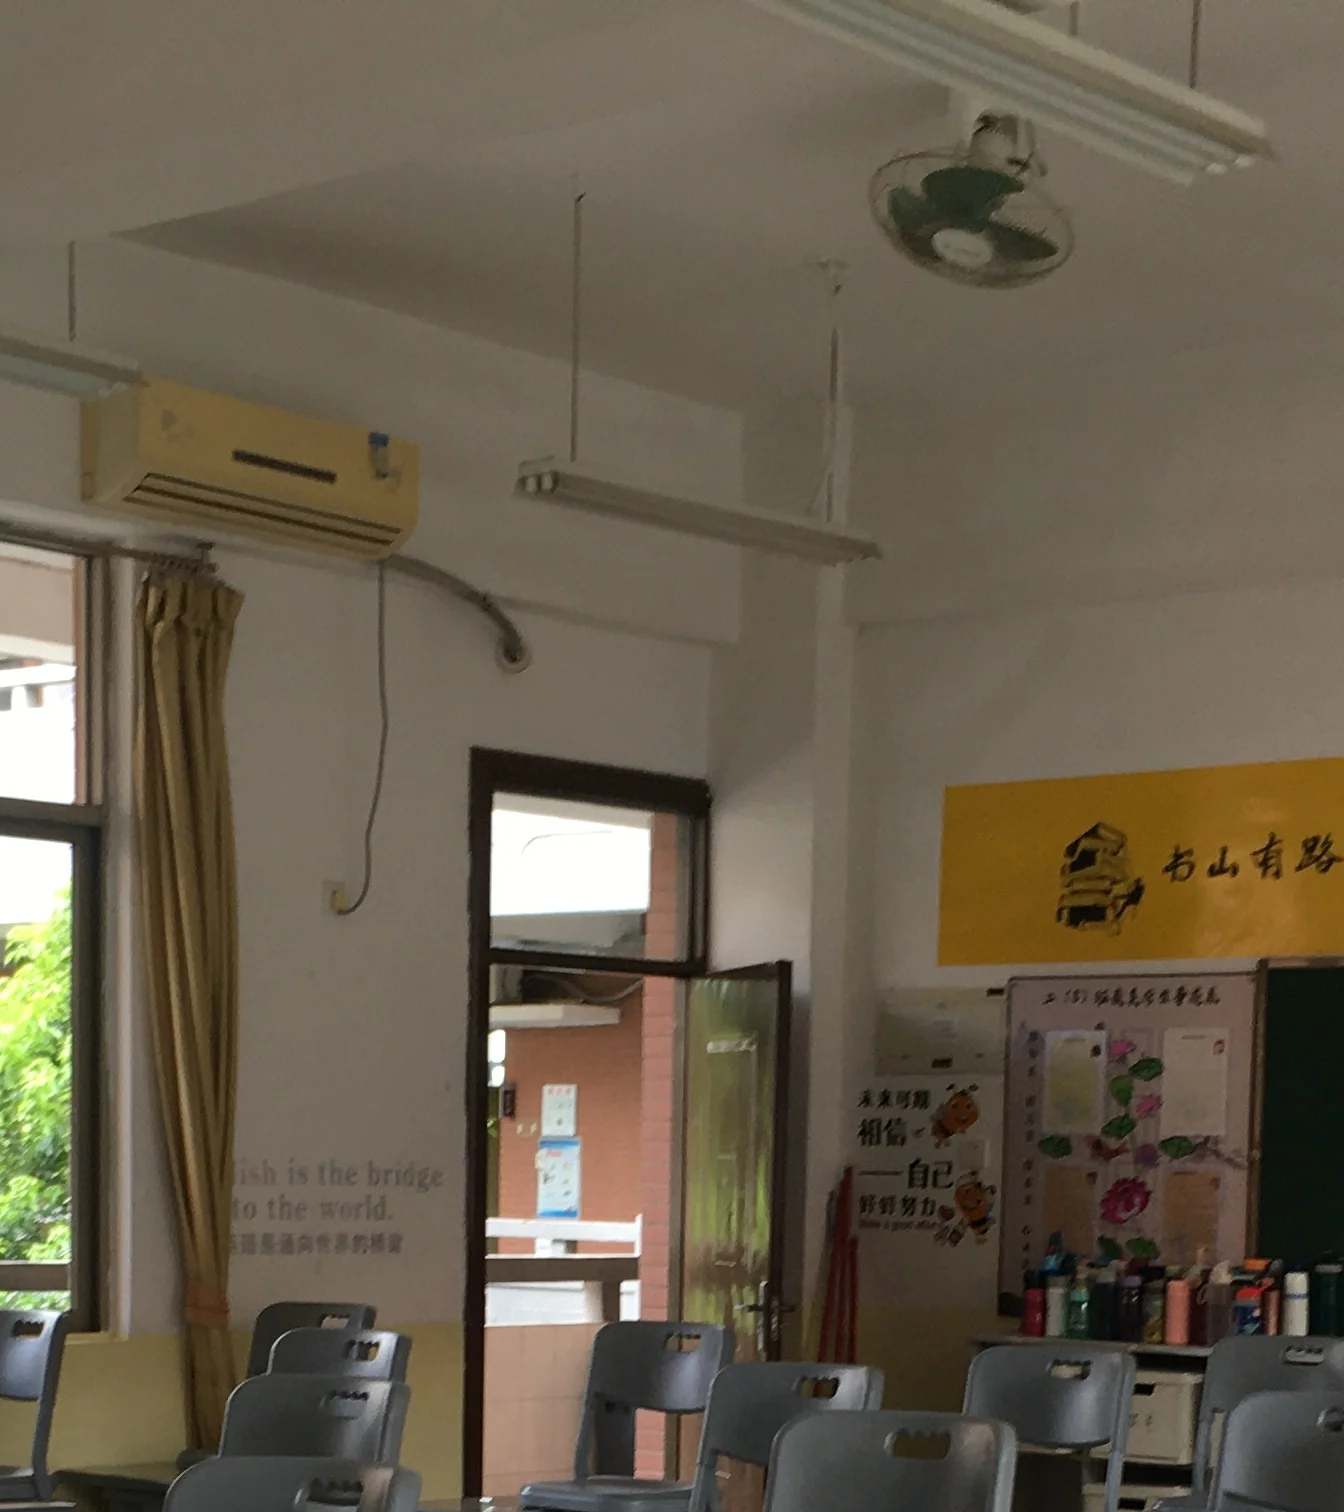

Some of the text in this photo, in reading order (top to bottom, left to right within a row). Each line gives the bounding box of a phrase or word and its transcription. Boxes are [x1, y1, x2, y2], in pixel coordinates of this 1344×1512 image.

[856, 1088, 931, 1110] 未来可期
[857, 1117, 907, 1147] 相信
[288, 1156, 308, 1187] is
[317, 1158, 358, 1187] the
[367, 1158, 444, 1193] bridge
[908, 1158, 954, 1190] 自己
[232, 1193, 394, 1221] to the world.
[858, 1194, 936, 1217] 好好努力
